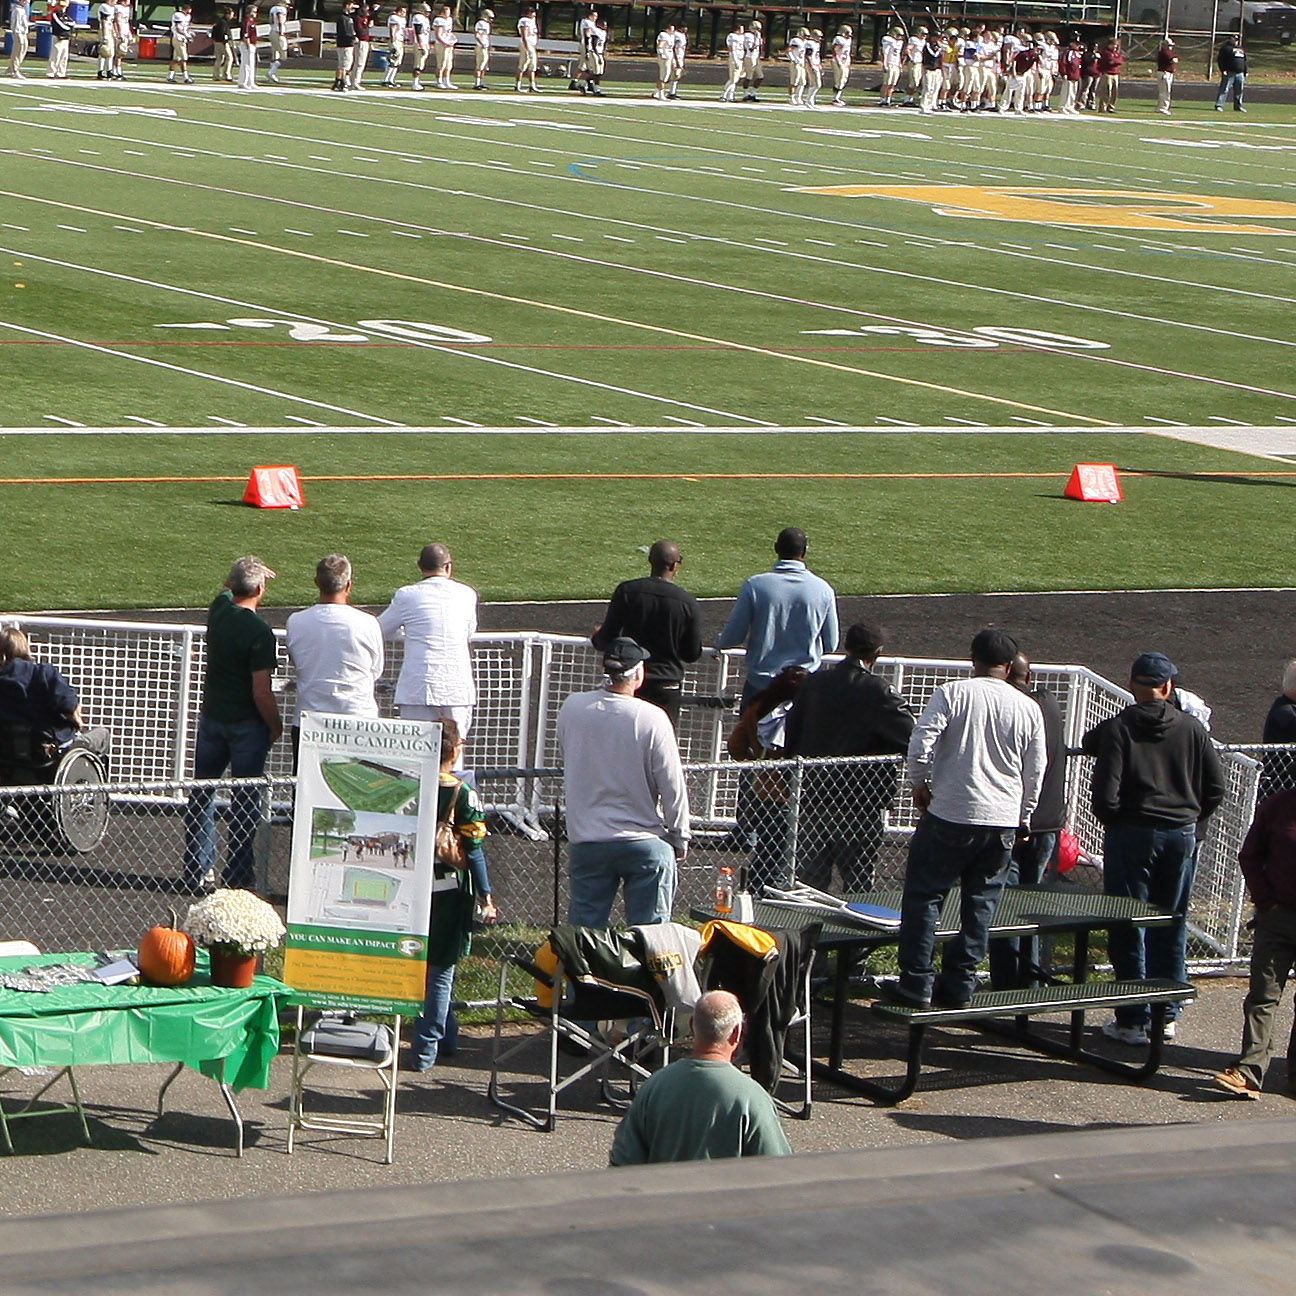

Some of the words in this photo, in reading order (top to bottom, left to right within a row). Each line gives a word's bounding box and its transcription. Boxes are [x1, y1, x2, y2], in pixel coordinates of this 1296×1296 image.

[322, 717, 352, 731] THE
[356, 721, 421, 736] PIONEER
[302, 731, 351, 745] SPIRIT
[354, 735, 438, 752] CAMPAIGN!
[289, 933, 308, 942] YOU
[308, 933, 327, 943] CAN
[327, 936, 351, 945] MAKE
[351, 938, 364, 946] AN
[365, 939, 397, 949] IMPACT
